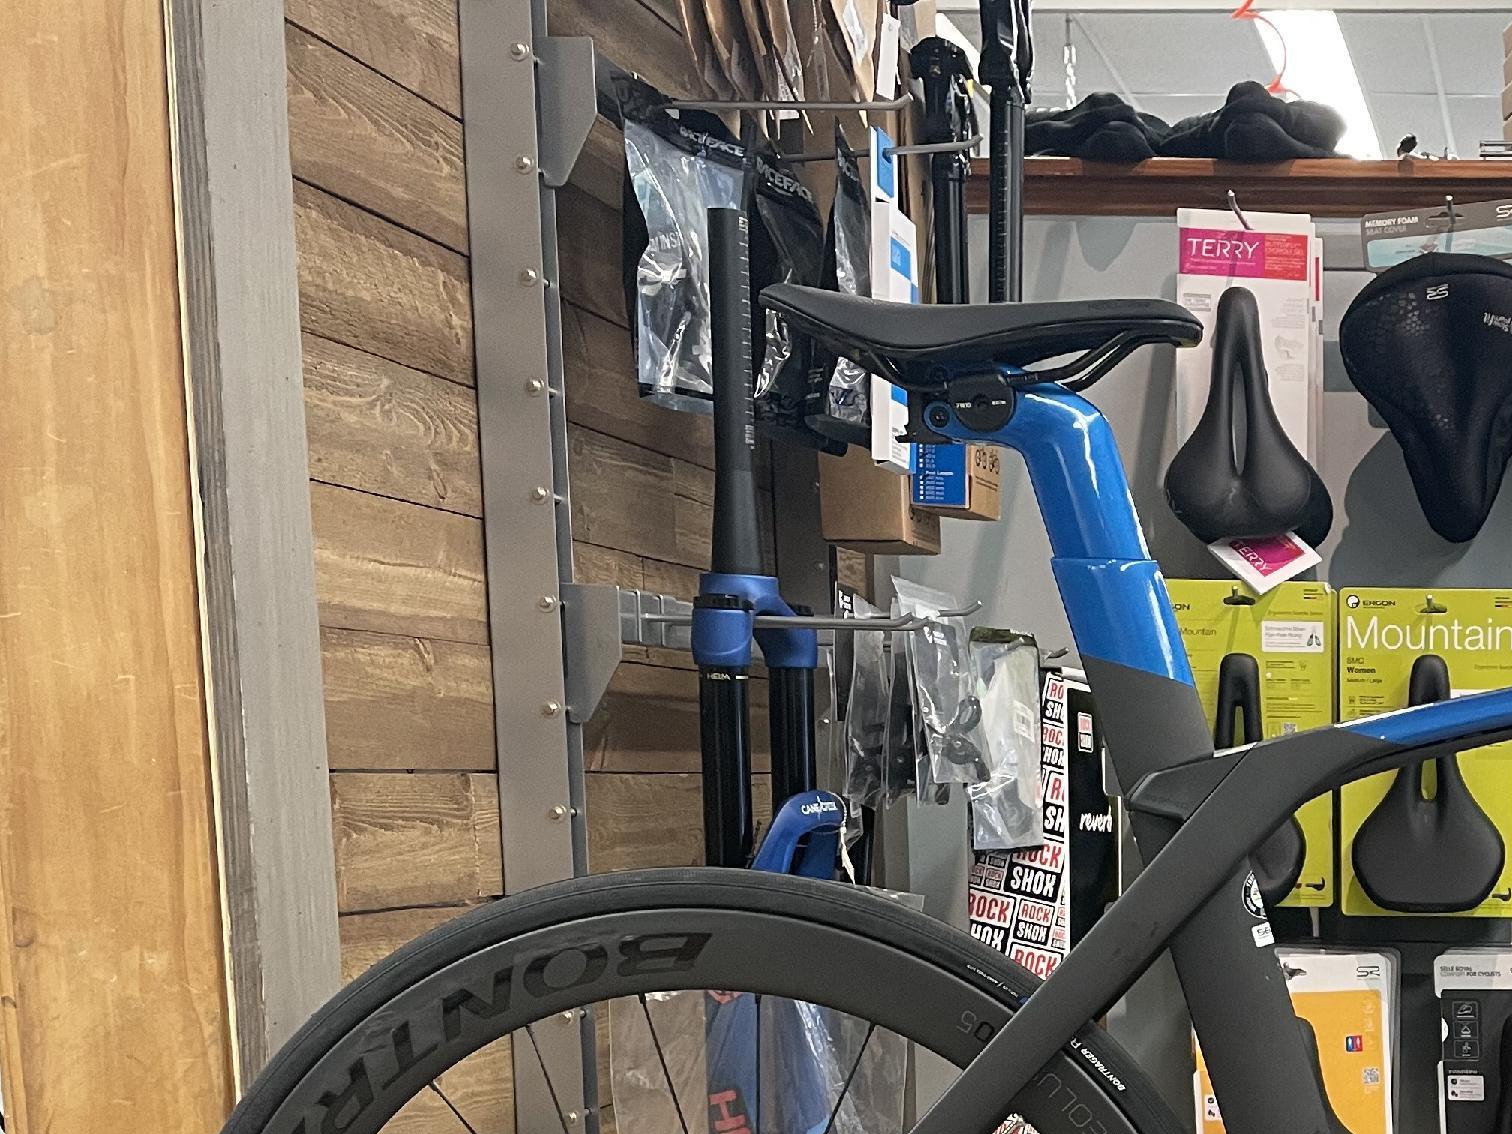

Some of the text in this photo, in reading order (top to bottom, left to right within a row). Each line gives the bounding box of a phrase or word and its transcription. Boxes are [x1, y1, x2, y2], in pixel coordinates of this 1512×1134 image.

[1364, 216, 1418, 227] MEMORY FOAM
[1187, 238, 1260, 259] TERRY
[1347, 657, 1364, 665] SMC
[1079, 805, 1113, 832] reverb
[1010, 866, 1057, 898] SHOX
[1021, 903, 1051, 923] ROCK
[1017, 921, 1047, 943] SHOX
[1256, 927, 1271, 935] 56
[1080, 1047, 1127, 1092] BONTRAGER
